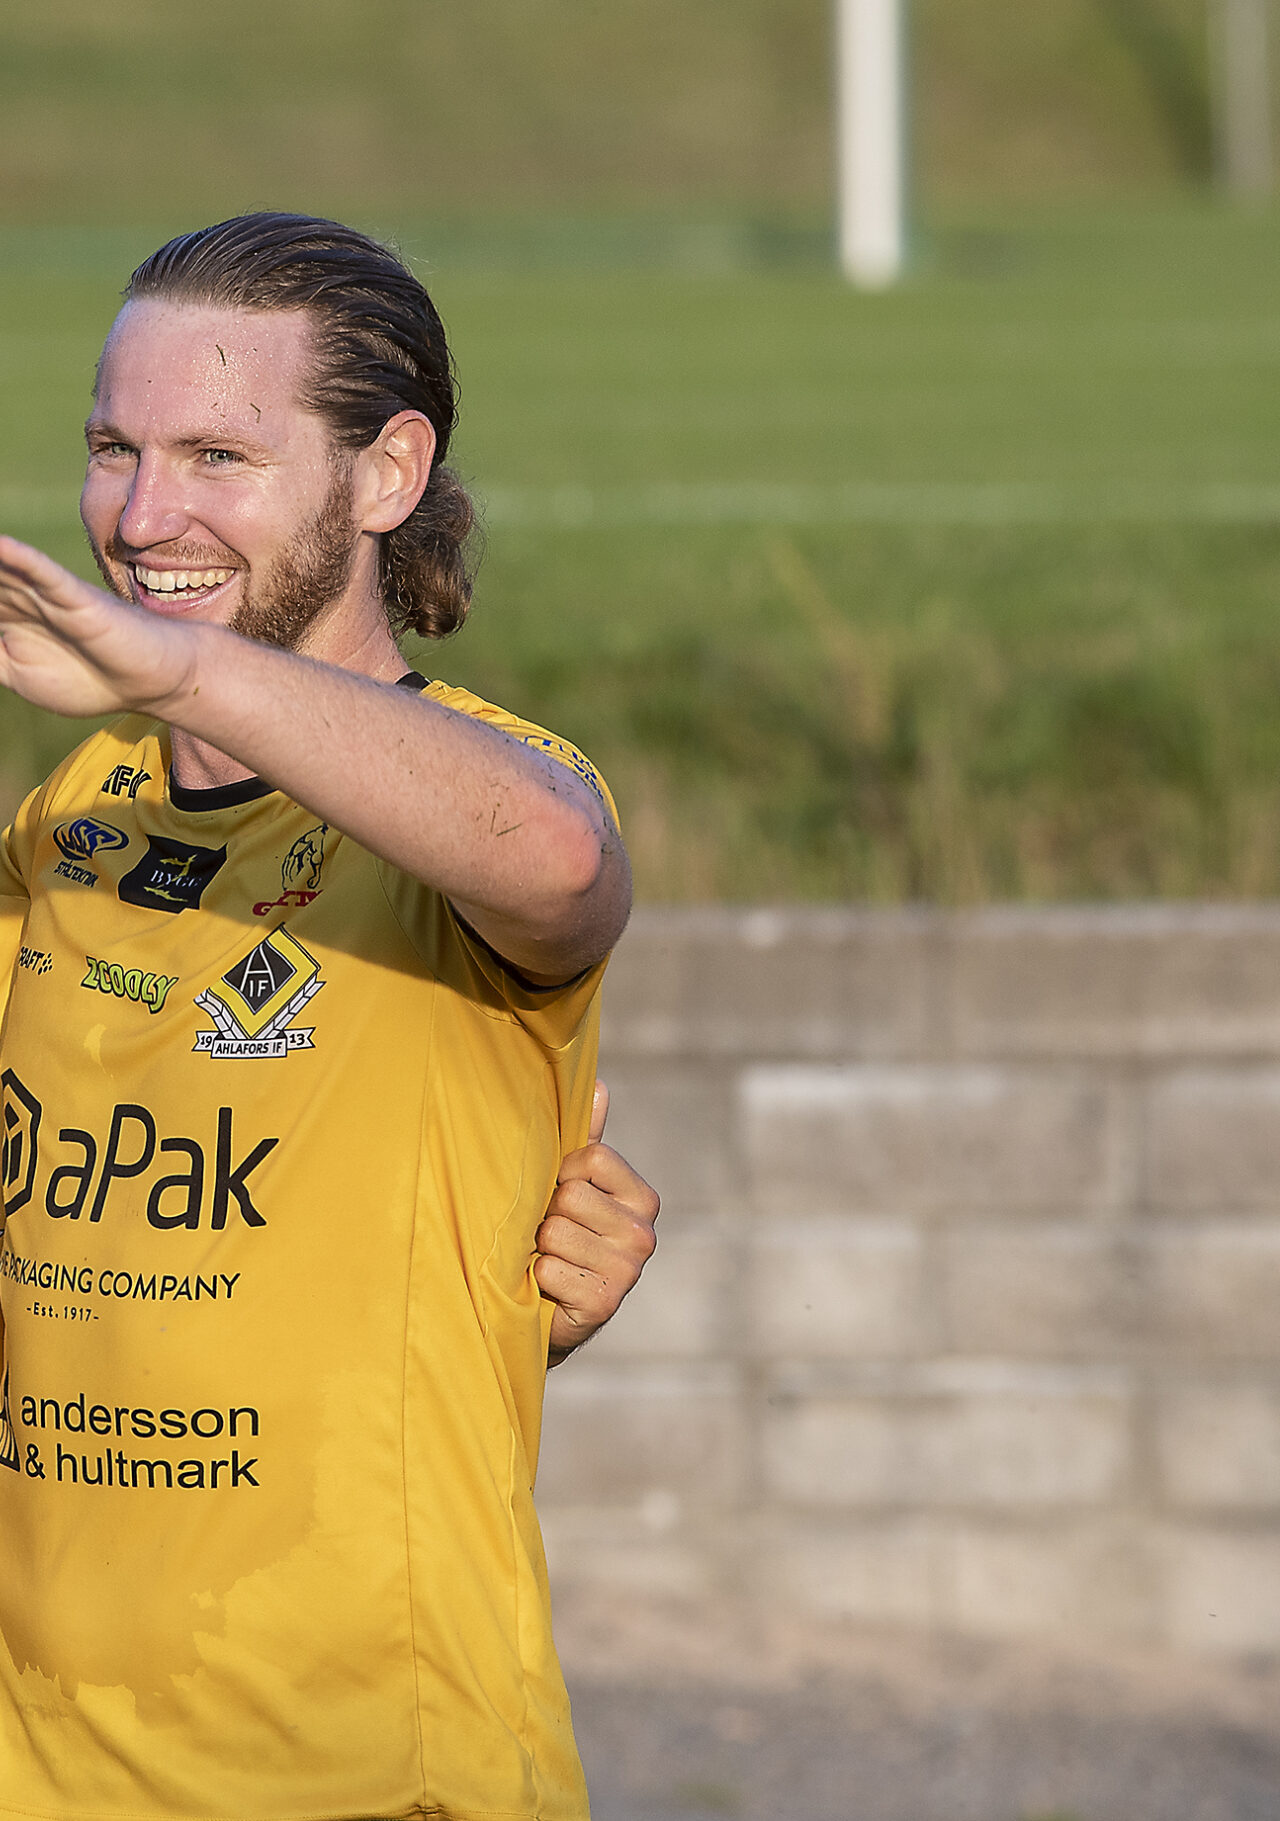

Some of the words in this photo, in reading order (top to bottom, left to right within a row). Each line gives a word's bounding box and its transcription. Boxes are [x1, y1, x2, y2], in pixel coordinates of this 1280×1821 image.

[19, 946, 45, 971] RAFT
[200, 1035, 213, 1048] 19
[215, 1042, 269, 1055] AHLAFORS
[272, 1042, 284, 1054] IF
[289, 1033, 305, 1046] 13
[45, 1103, 280, 1231] aPak
[8, 1252, 94, 1294] PACKAGING
[99, 1270, 241, 1301] COMPANY
[20, 1392, 259, 1439] andersson
[25, 1443, 46, 1480] &
[56, 1442, 260, 1489] hultmark
